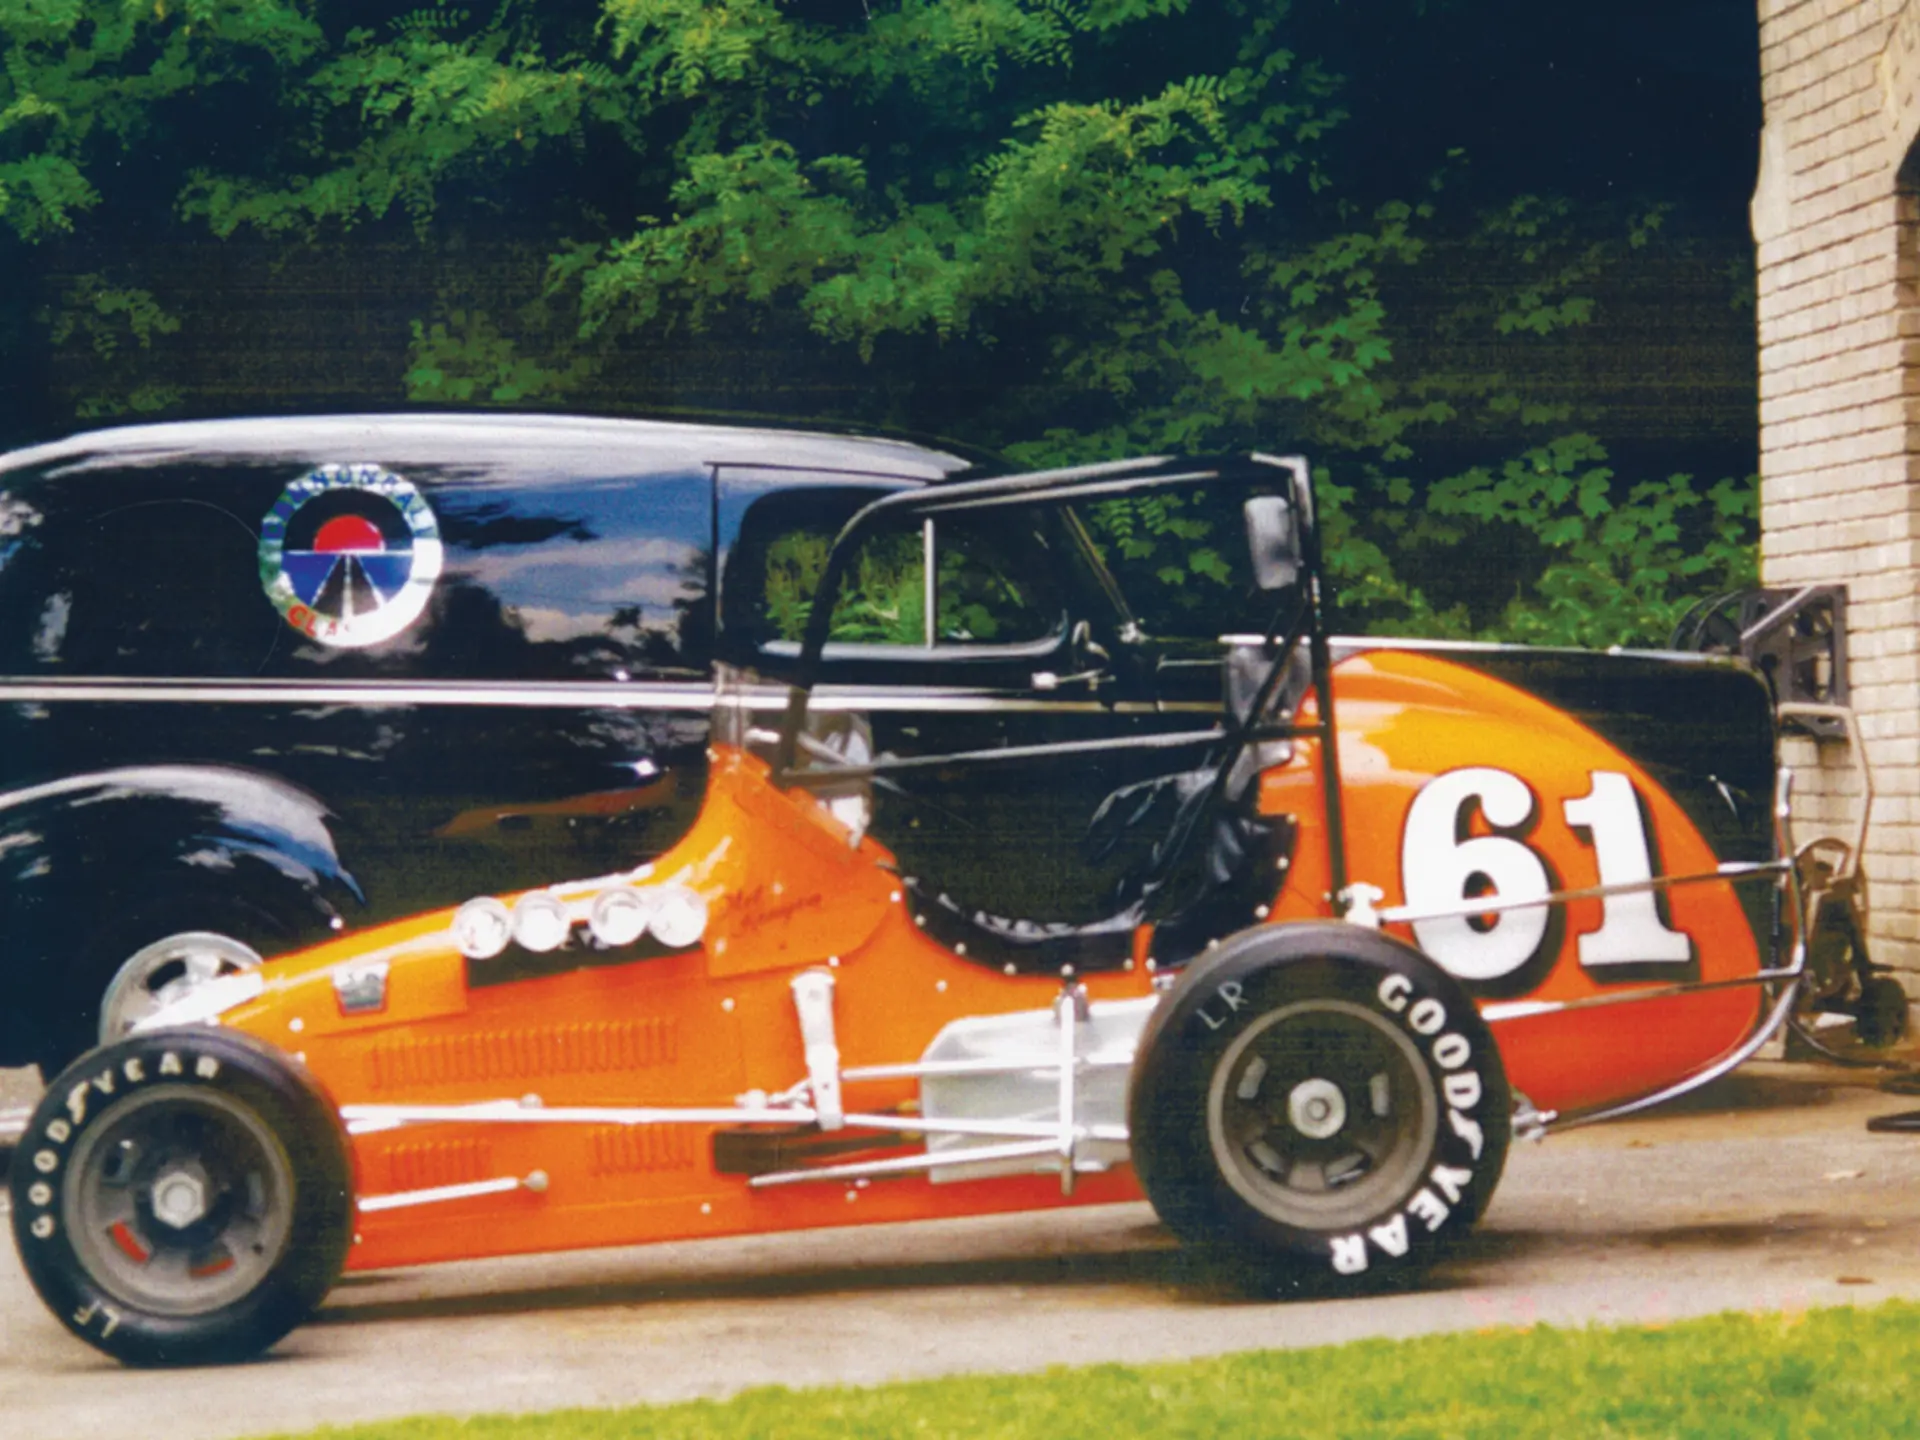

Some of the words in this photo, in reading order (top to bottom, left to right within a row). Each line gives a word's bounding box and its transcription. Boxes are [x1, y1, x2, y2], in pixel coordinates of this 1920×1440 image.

[1402, 767, 1692, 981] 61
[1196, 981, 1248, 1030] LR
[28, 1051, 220, 1239] GOODYEAR
[1331, 972, 1485, 1275] GOODYEAR
[73, 1300, 121, 1339] LF
